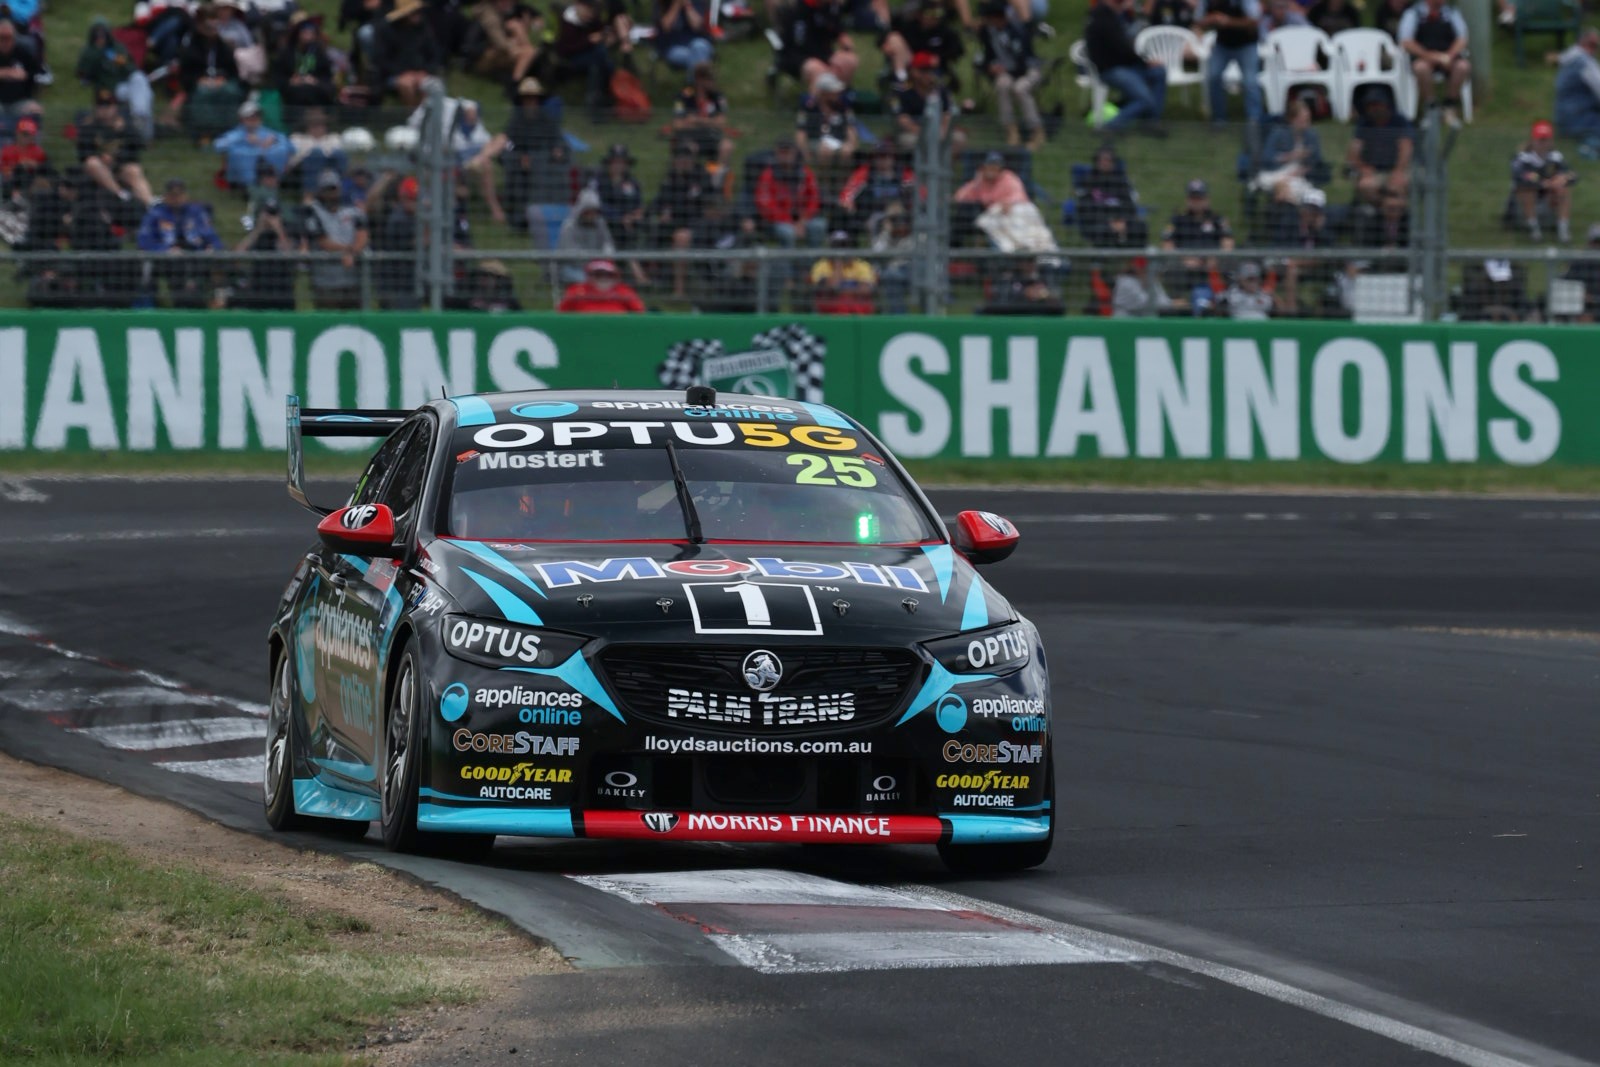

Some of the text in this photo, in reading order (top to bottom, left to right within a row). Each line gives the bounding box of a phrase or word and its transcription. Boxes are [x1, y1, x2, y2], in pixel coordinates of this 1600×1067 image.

[878, 333, 1563, 465] SHANNONS
[478, 449, 605, 470] Mostert
[786, 453, 877, 488] 25
[533, 557, 930, 593] Mobil
[815, 585, 840, 593] TM
[723, 583, 771, 626] 1
[450, 620, 541, 663] OPTUS
[967, 630, 1029, 668] OPTUS
[474, 686, 583, 708] appliances
[668, 688, 751, 723] PALM
[972, 694, 1046, 718] appliances
[518, 708, 582, 725] online
[644, 736, 873, 754] lloydsauctions.com.au
[480, 785, 552, 800] AUTOCARE
[953, 794, 1014, 806] AUTOCARE
[688, 814, 783, 831] MORRIS
[790, 816, 891, 836] FINANCE
